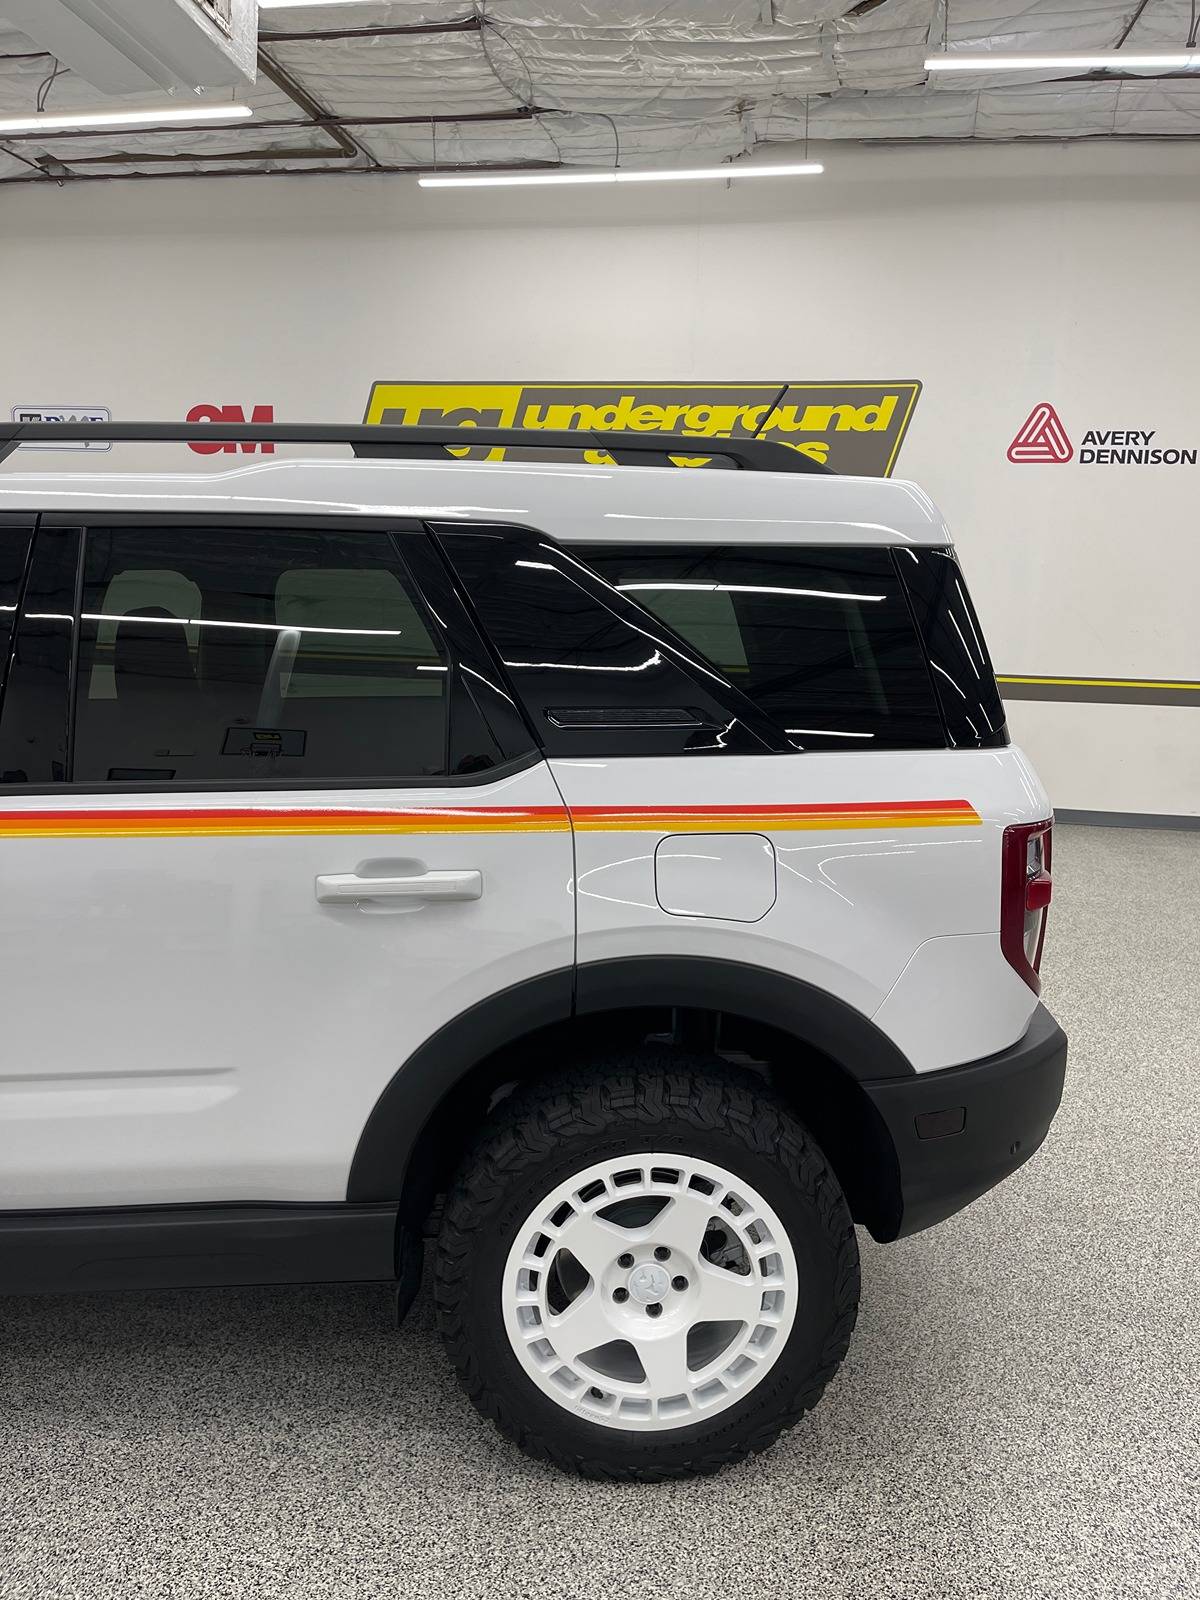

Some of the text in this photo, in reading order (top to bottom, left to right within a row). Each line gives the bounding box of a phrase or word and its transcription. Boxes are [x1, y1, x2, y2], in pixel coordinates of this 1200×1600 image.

[522, 396, 899, 438] underground
[1081, 431, 1156, 446] AVERY
[1079, 449, 1198, 464] DENNISON
